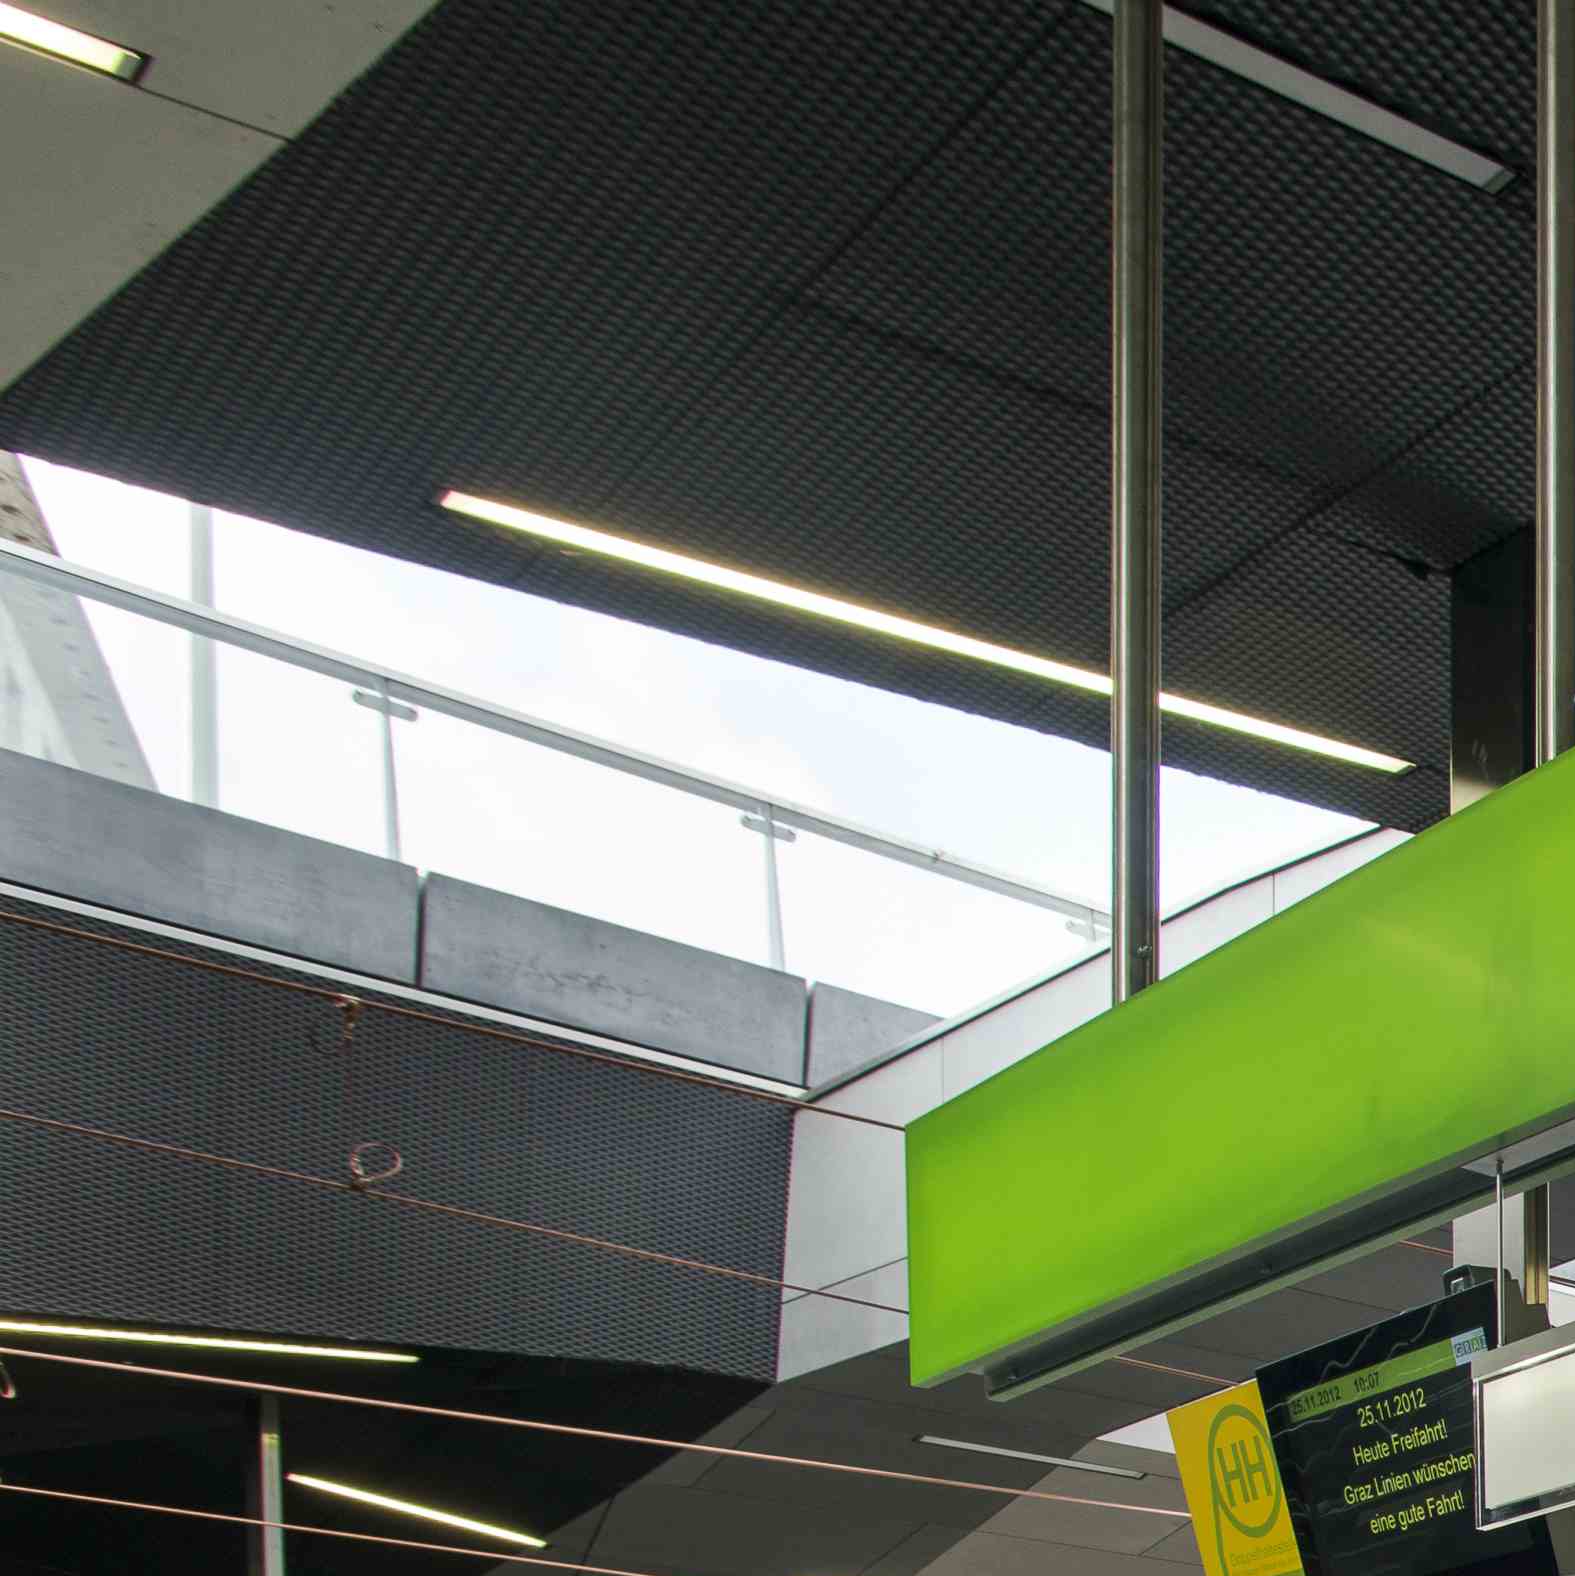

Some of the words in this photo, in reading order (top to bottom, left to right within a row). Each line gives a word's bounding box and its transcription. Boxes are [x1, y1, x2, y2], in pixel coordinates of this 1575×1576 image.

[1354, 1372, 1380, 1393] 10:07
[1357, 1388, 1427, 1427] 25.11.2012
[1353, 1441, 1390, 1466] Heute
[1391, 1418, 1448, 1454] Freifahrt!
[1344, 1484, 1374, 1505] Graz
[1374, 1472, 1412, 1496] Linien
[1413, 1453, 1476, 1485] wünschen
[1370, 1514, 1396, 1534] eine
[1398, 1504, 1426, 1531] gute
[1426, 1489, 1465, 1518] Fahrt!
